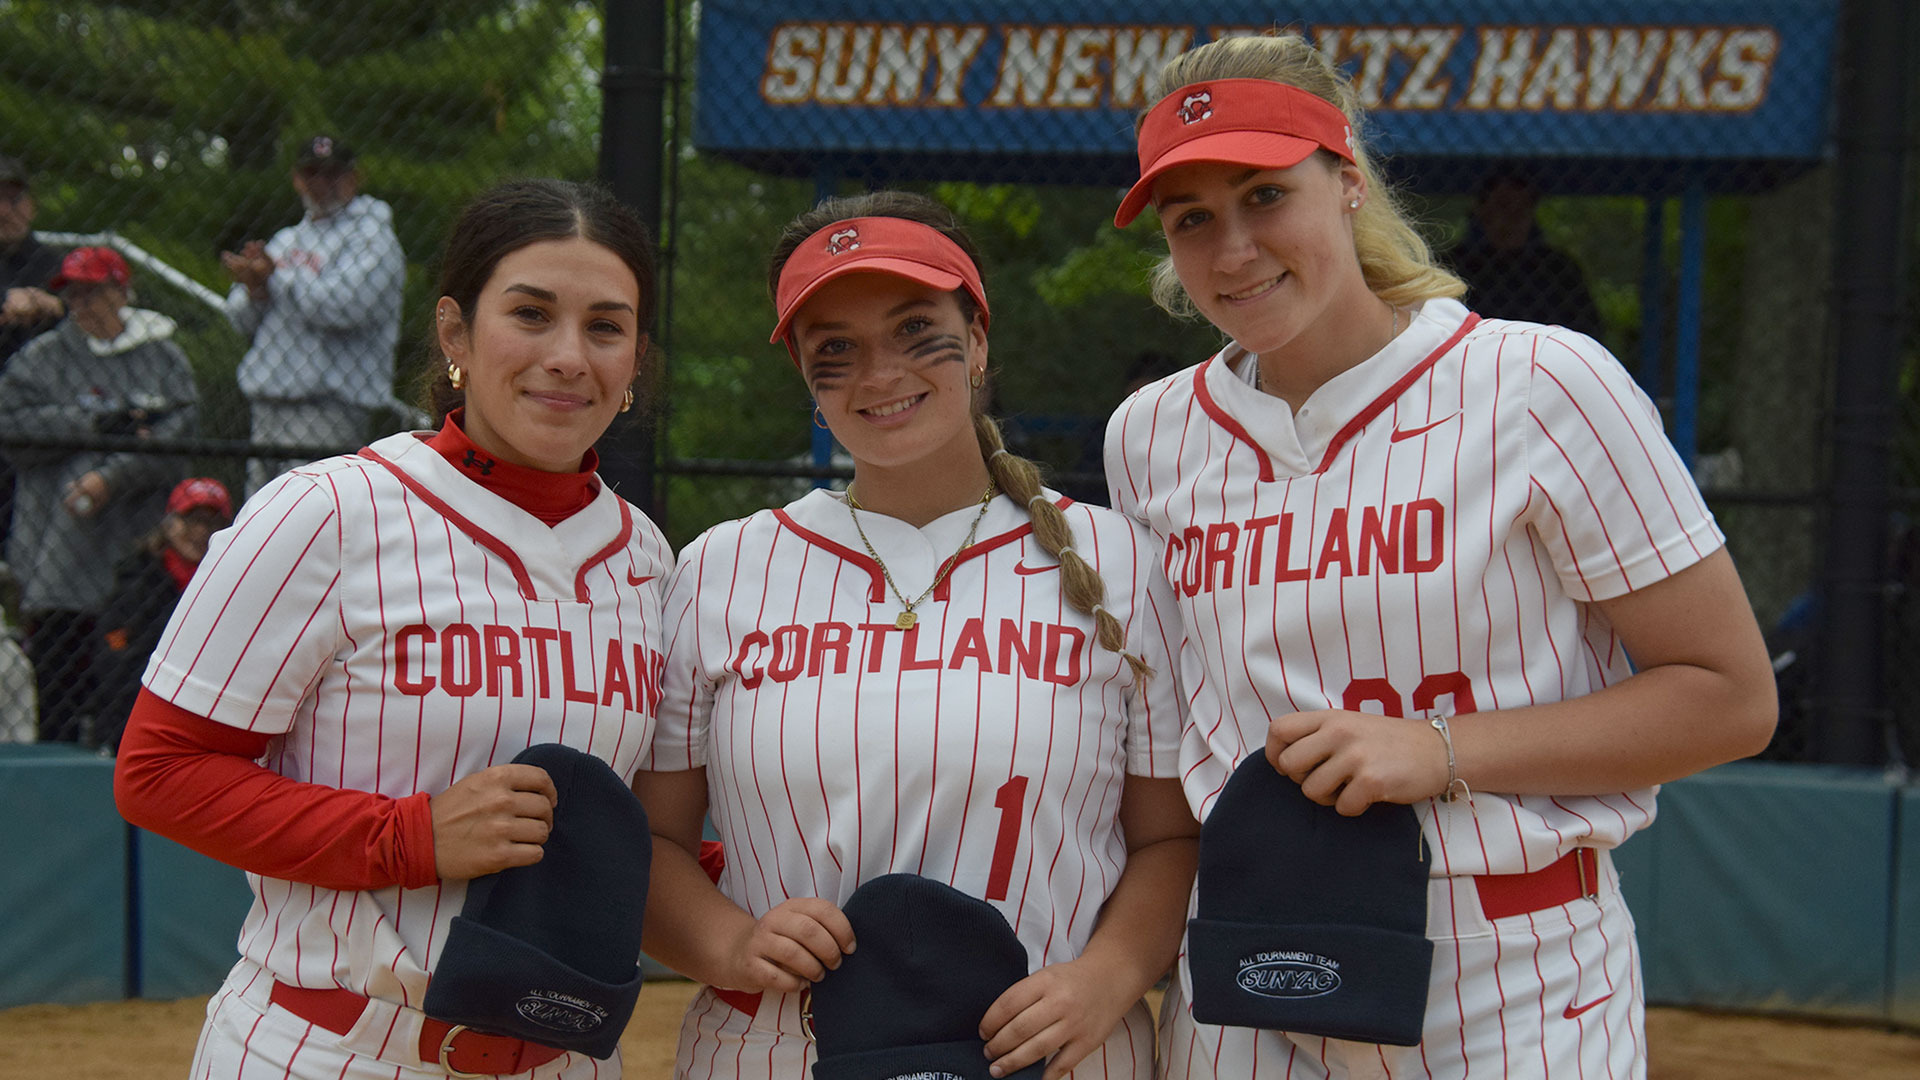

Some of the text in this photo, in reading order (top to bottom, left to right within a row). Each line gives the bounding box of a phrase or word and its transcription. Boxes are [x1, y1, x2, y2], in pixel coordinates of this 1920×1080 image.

[761, 22, 989, 107] SUNY
[980, 24, 1196, 108] NEW
[1453, 25, 1779, 112] HAWKS
[1164, 497, 1444, 600] CORTLAND
[733, 618, 1085, 690] CORTLAND
[985, 775, 1029, 902] 1
[1239, 951, 1338, 969] ALL TOURNAMENT TEAM
[1243, 970, 1333, 990] SUNYAC
